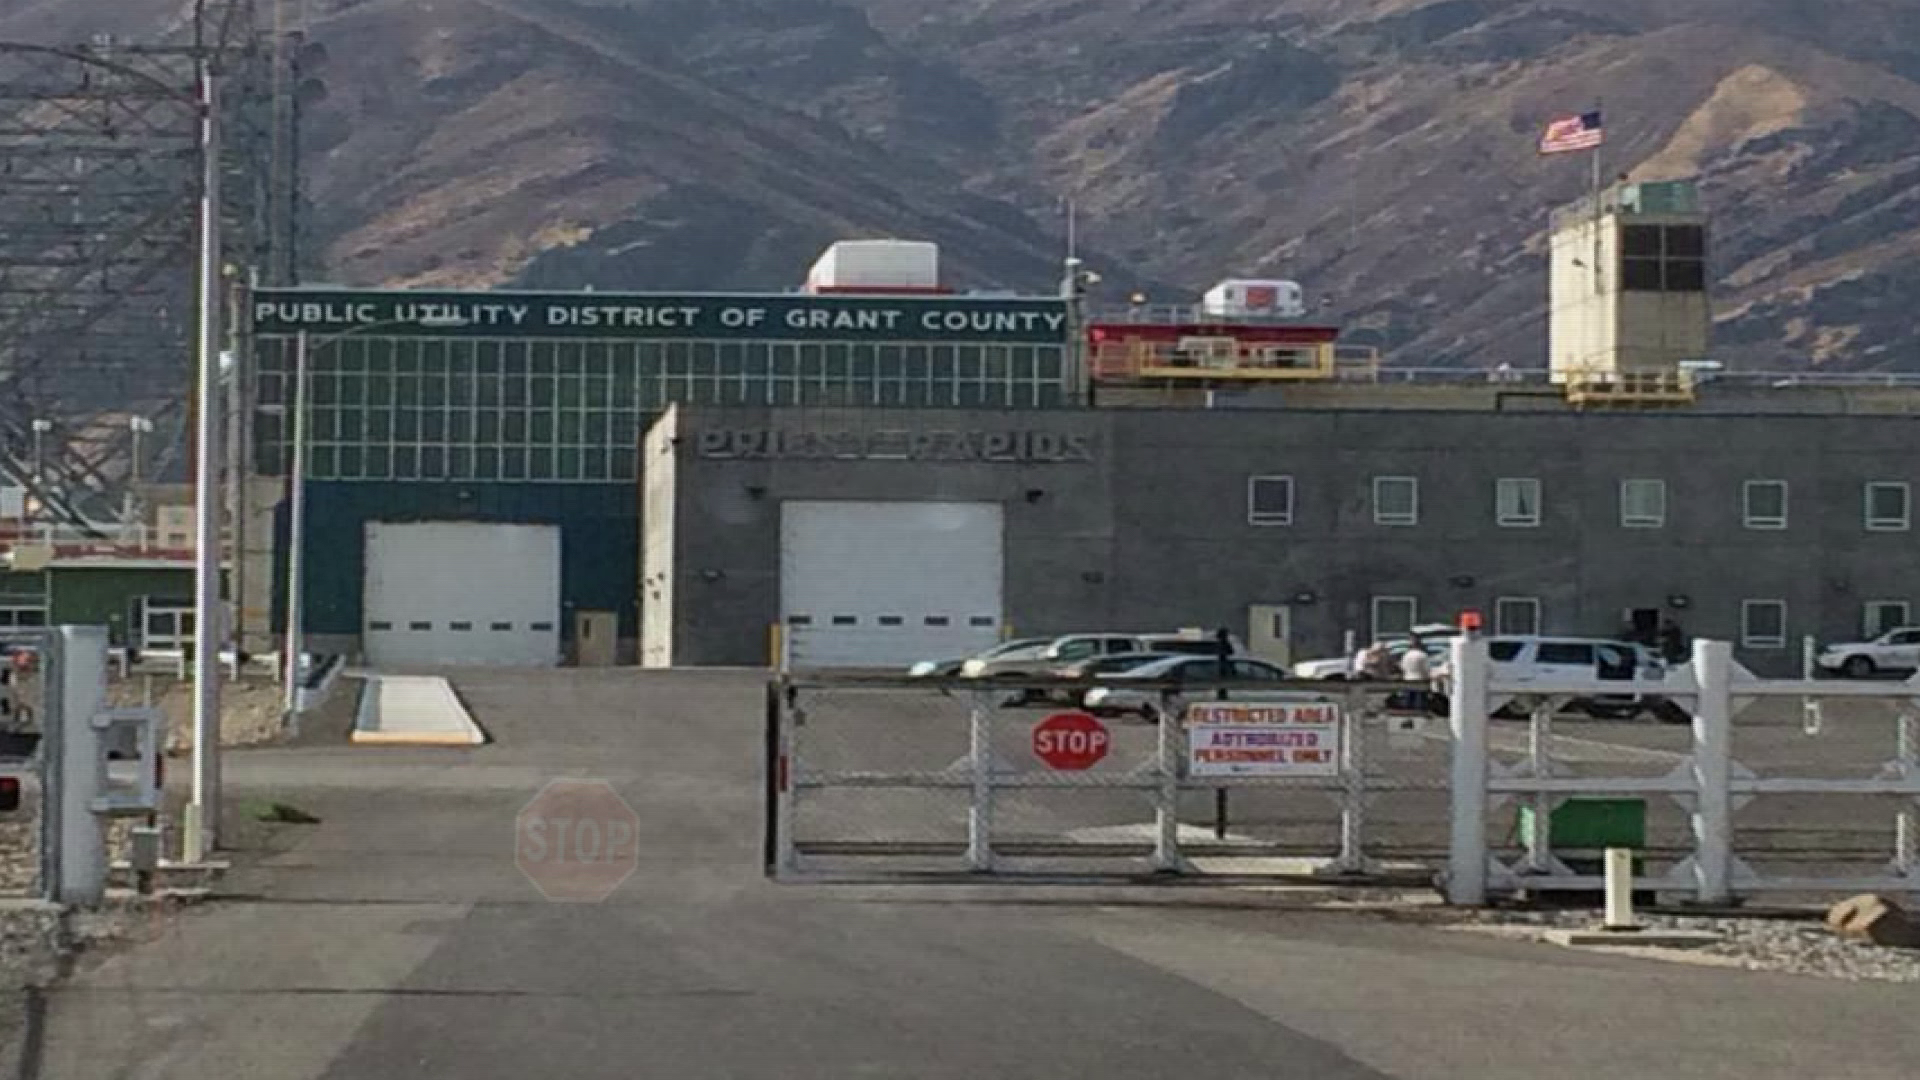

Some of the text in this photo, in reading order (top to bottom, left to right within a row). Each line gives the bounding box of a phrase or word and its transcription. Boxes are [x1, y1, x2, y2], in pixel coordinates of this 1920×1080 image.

[255, 302, 1065, 331] PUBLIC UTILITY DISTRICT OF GRANT COUNTY
[908, 430, 1094, 462] RAPIDS
[1036, 729, 1106, 754] STOP
[524, 816, 631, 865] STOP
